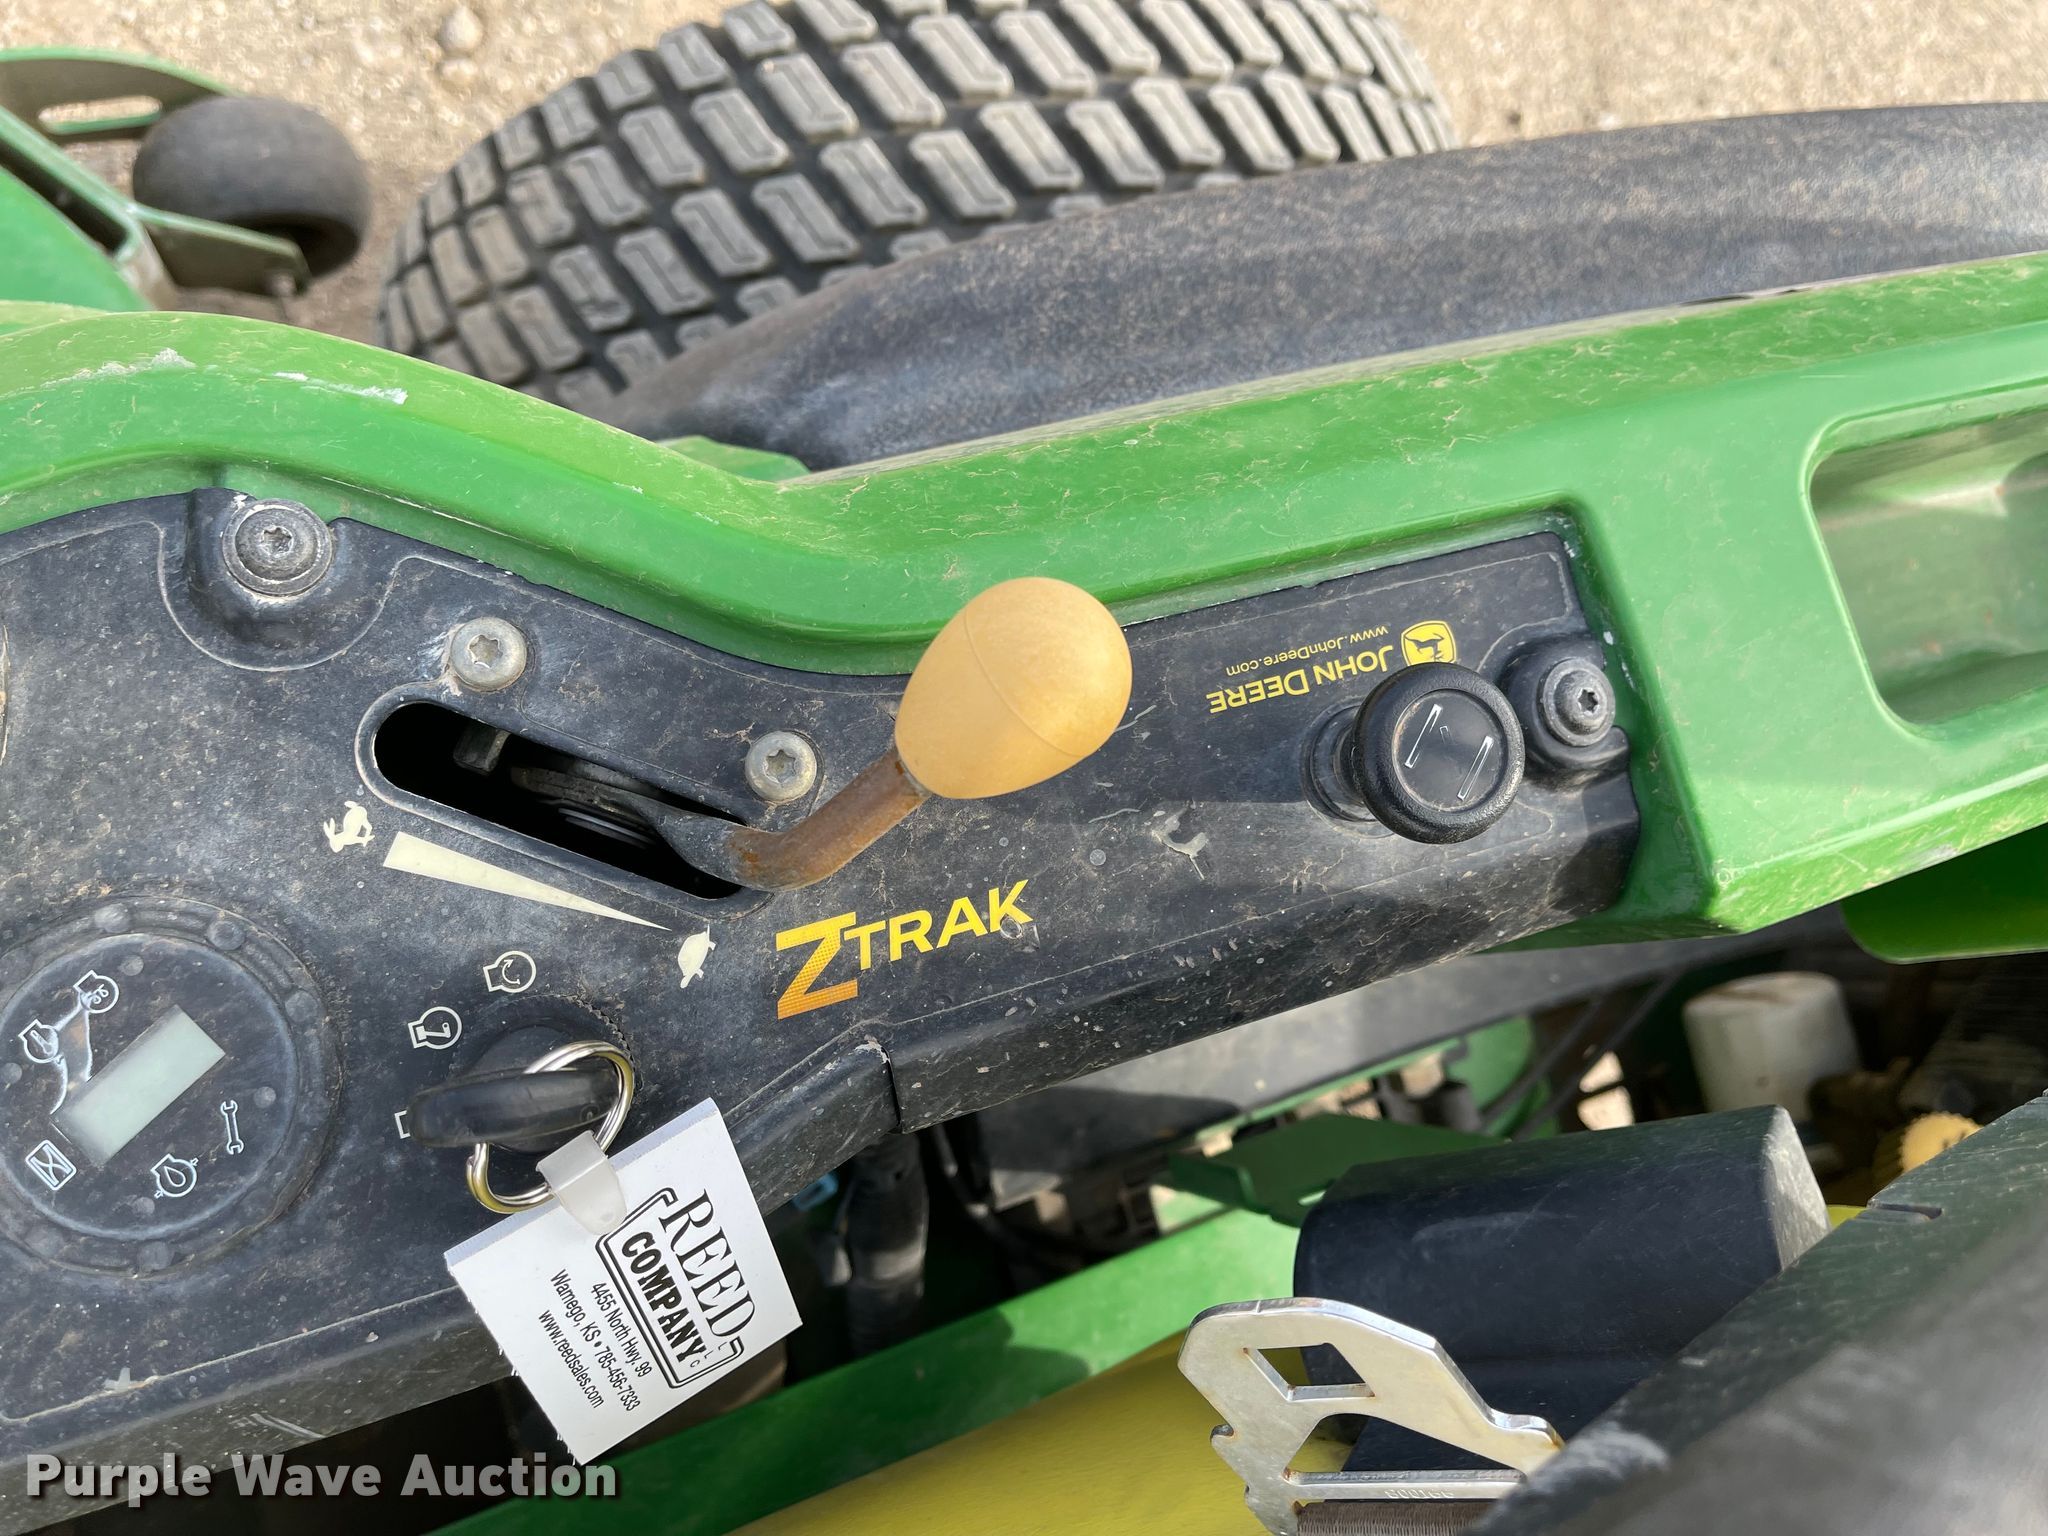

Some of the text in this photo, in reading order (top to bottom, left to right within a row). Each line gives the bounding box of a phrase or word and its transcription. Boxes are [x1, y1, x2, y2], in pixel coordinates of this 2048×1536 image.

[1205, 645, 1394, 714] JOHN DEERE
[1225, 625, 1389, 677] www.JohnDeere.com
[621, 1231, 707, 1363] COMPANY
[658, 1188, 756, 1338] REED
[538, 1309, 605, 1409] www.reedsales.com
[550, 1269, 641, 1412] Wamego, KS 785-456-7333
[590, 1282, 653, 1378] 4455 North Hwy. 99
